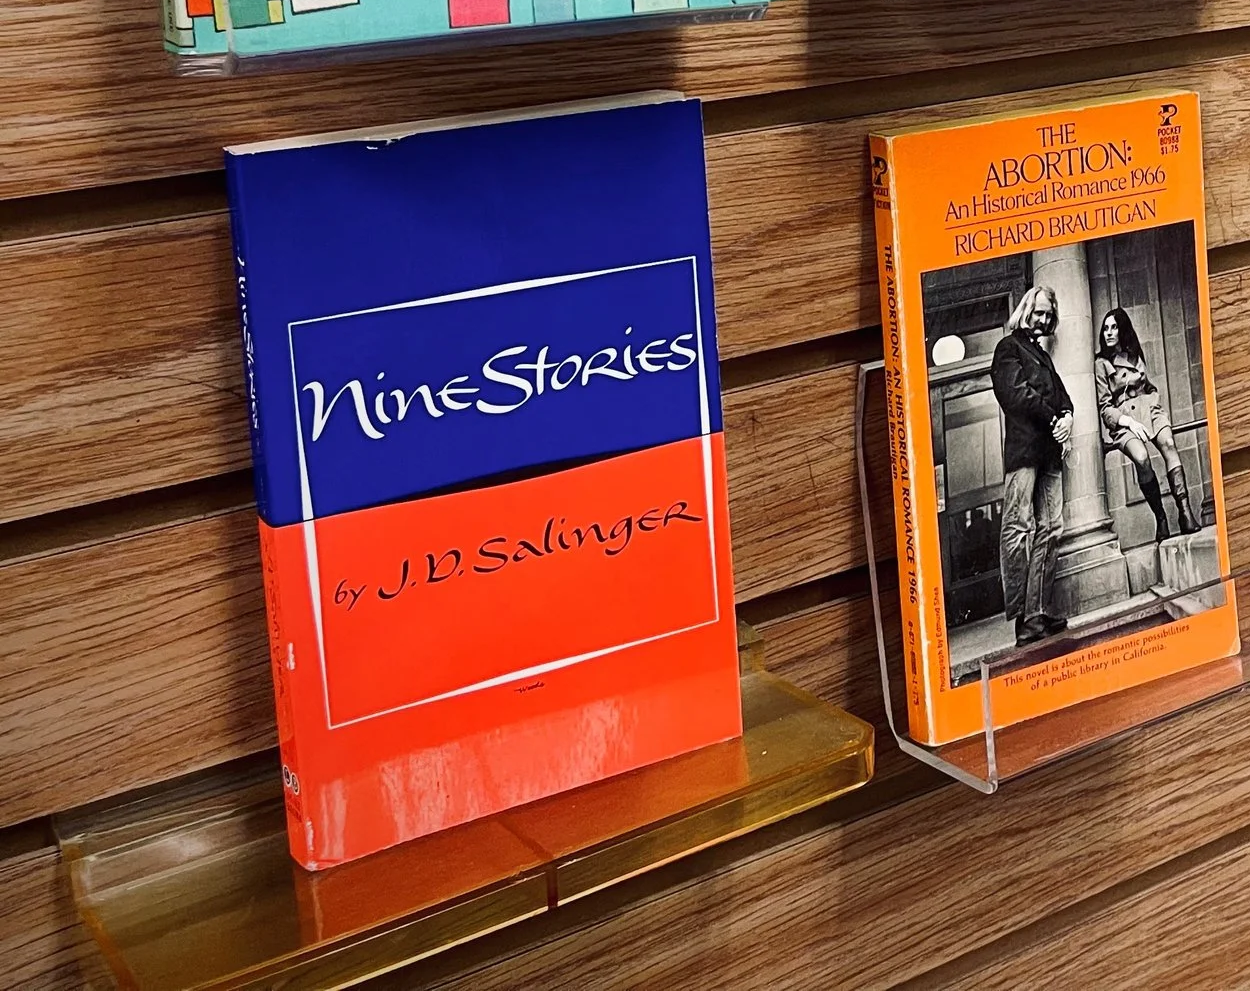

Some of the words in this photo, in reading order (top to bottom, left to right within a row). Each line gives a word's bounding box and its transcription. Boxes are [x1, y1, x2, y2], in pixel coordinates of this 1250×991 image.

[1036, 122, 1076, 148] THE
[1157, 125, 1181, 137] POCKET
[945, 199, 970, 222] An
[973, 188, 1049, 218] Historical
[1052, 175, 1128, 204] Romance
[1130, 165, 1167, 188] 1966
[983, 140, 1133, 191] ABORTION:
[954, 218, 1045, 257] RICHARD
[1048, 199, 1157, 239] BRAUTIGAN
[884, 245, 894, 273] THE
[887, 276, 901, 362] ABORTION:
[304, 372, 477, 442] Nine
[474, 325, 699, 415] Stories
[885, 369, 895, 419] Richard
[893, 365, 902, 390] AN
[889, 422, 898, 480] Brautigan
[895, 395, 909, 485] HISTORICAL
[332, 578, 369, 612] by
[471, 498, 703, 573] Salinger
[901, 489, 916, 568] ROMANCE
[908, 570, 918, 605] 1966
[1003, 672, 1023, 687] This
[1026, 666, 1050, 683] novel
[1051, 664, 1059, 673] is
[1061, 655, 1086, 670] about
[1087, 649, 1101, 661] the
[1103, 638, 1141, 656] romantic
[1142, 623, 1190, 648] possibilities
[1030, 680, 1041, 691] of
[1043, 679, 1049, 687] a
[1050, 669, 1077, 687] public
[1079, 660, 1110, 677] library
[1111, 655, 1121, 666] in
[1122, 644, 1168, 662] California.
